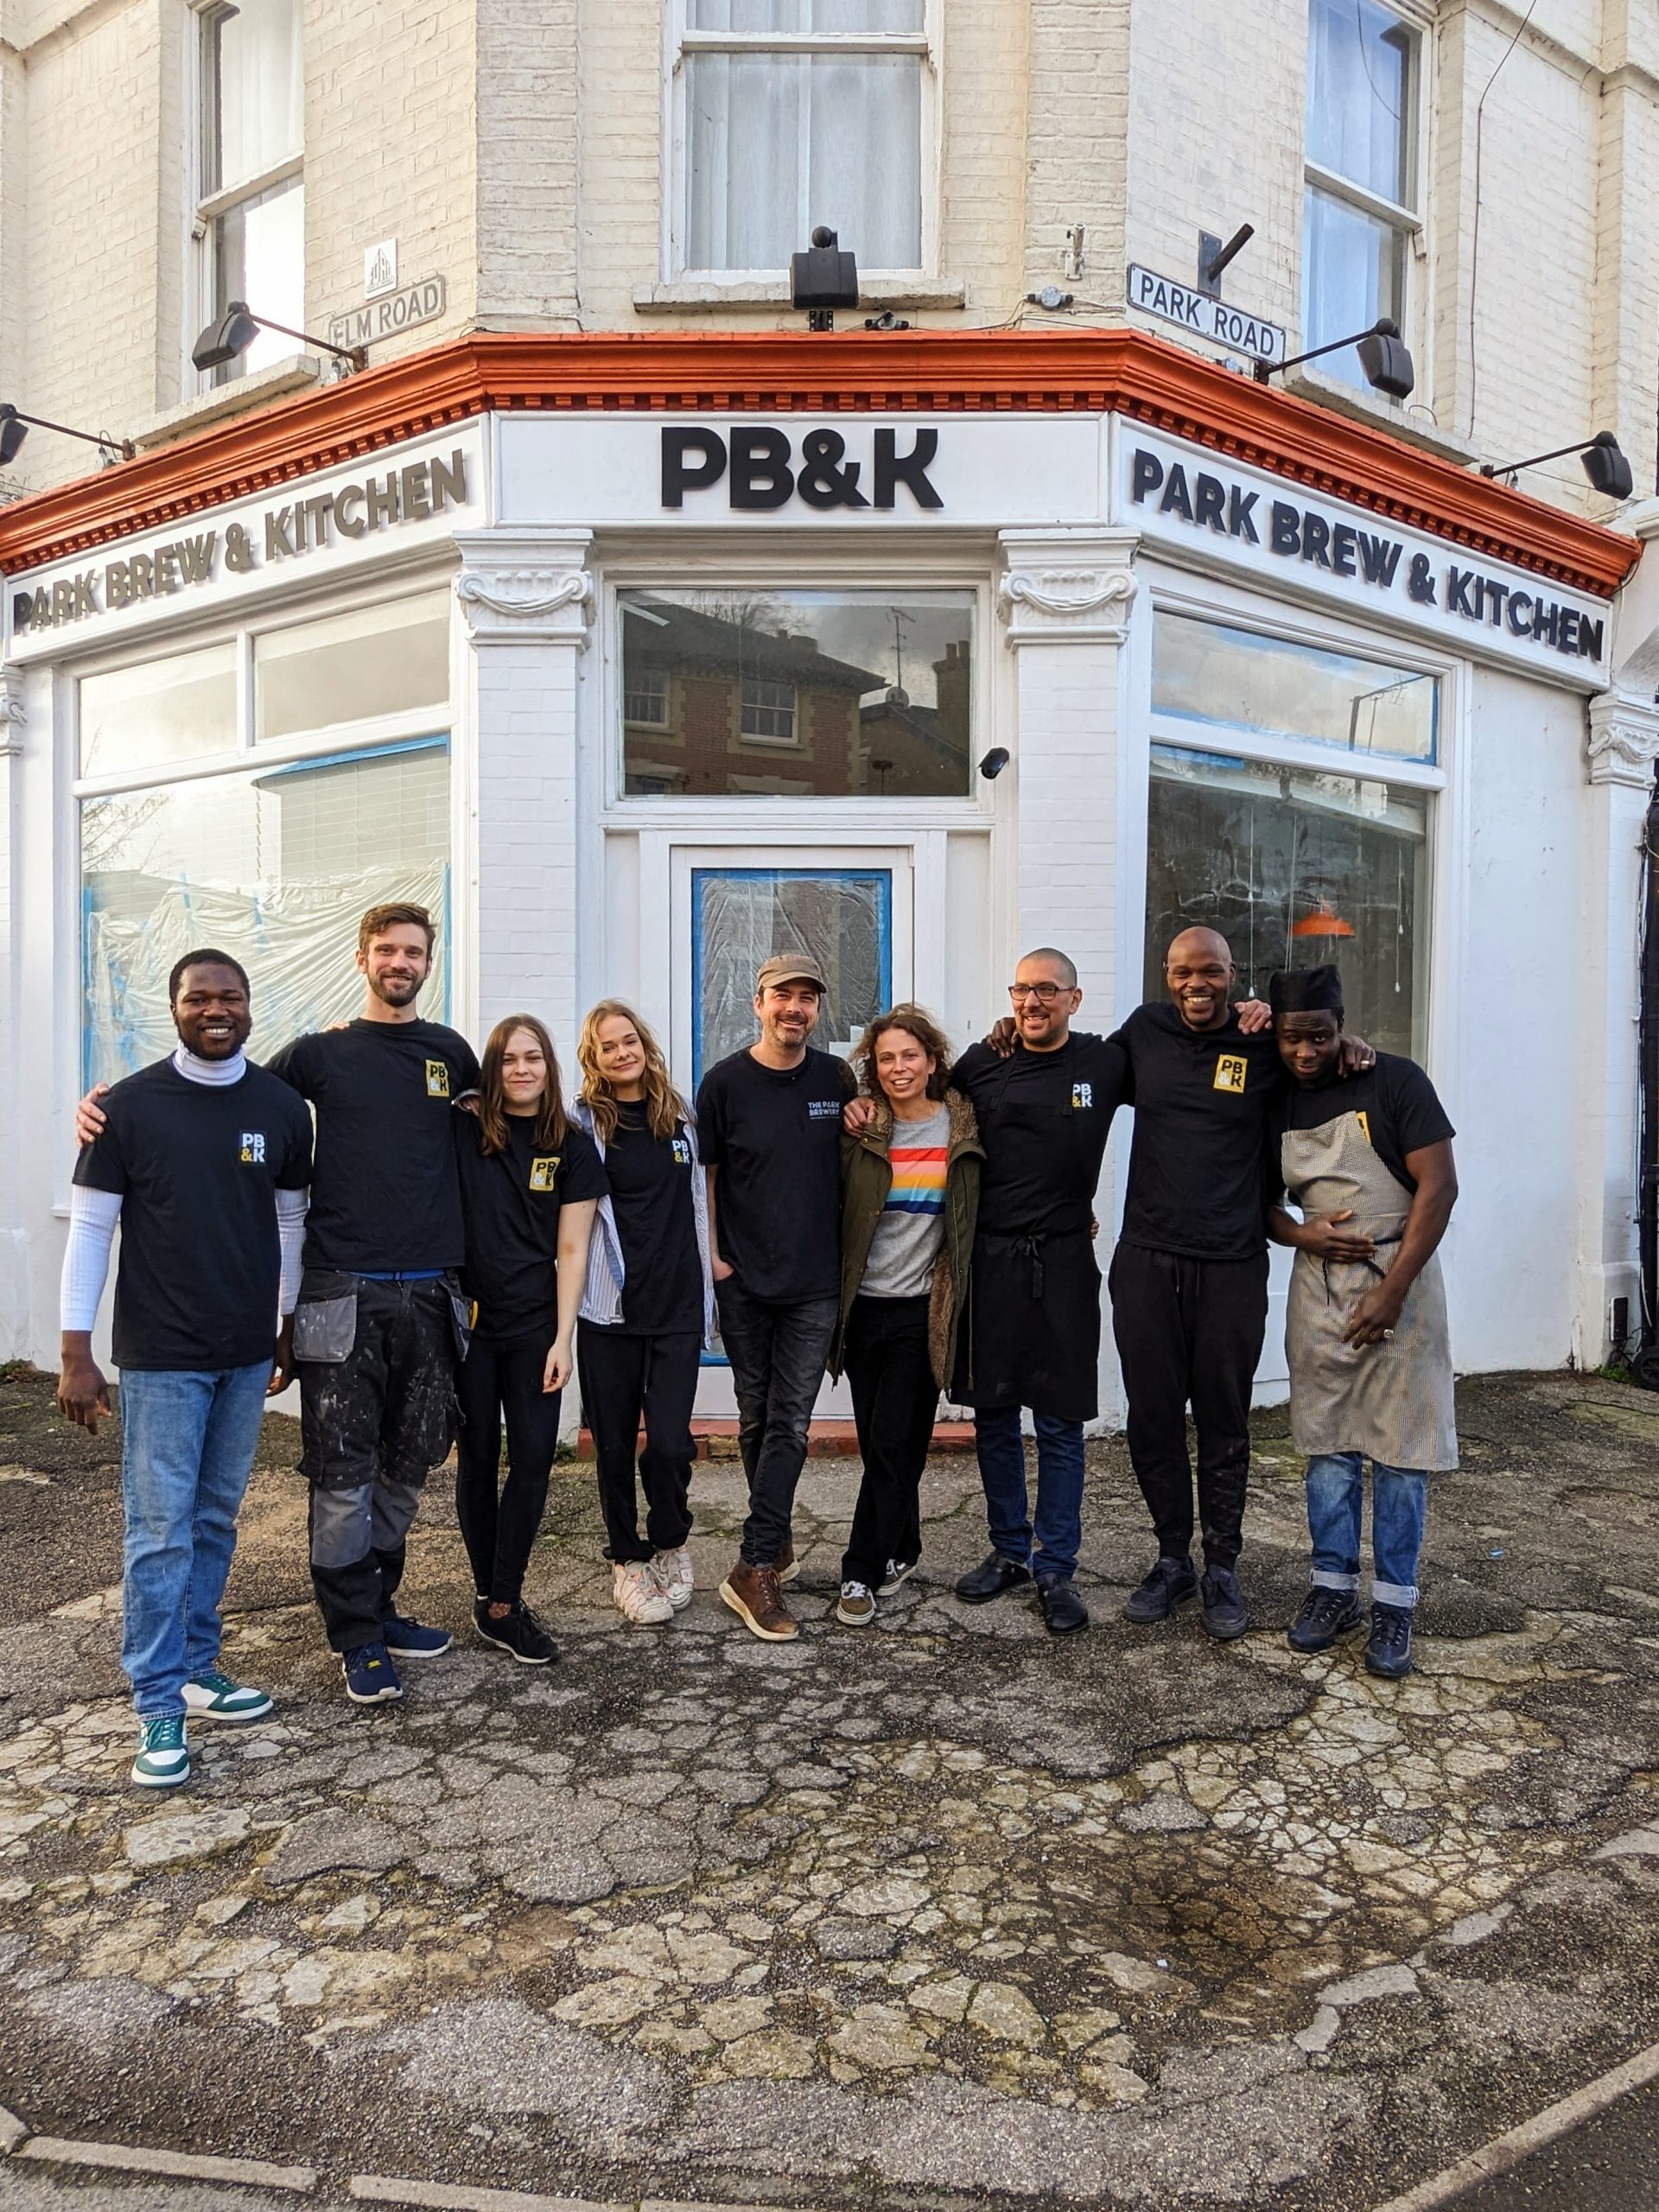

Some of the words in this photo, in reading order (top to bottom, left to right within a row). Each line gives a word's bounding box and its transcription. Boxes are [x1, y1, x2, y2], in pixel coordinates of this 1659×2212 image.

[379, 283, 439, 334] ROAD
[1141, 273, 1202, 328] PARK
[1214, 307, 1274, 356] ROAD
[661, 427, 944, 508] PB&K
[13, 569, 99, 636] PARK
[106, 531, 216, 608] BREW
[225, 523, 252, 572] &
[264, 448, 466, 562] KITCHEN
[1133, 448, 1261, 544] PARK
[1272, 499, 1403, 588] BREW
[1409, 552, 1438, 606] &
[1448, 564, 1604, 662] KITCHEN
[429, 1064, 446, 1078] PB
[1222, 1059, 1243, 1074] PB
[1219, 1071, 1242, 1087] &K
[1072, 1084, 1092, 1096] PB
[1072, 1095, 1093, 1108] &K
[242, 1133, 265, 1147] PB
[671, 1140, 689, 1152] PB
[240, 1147, 265, 1162] &K
[536, 1161, 556, 1173] PB
